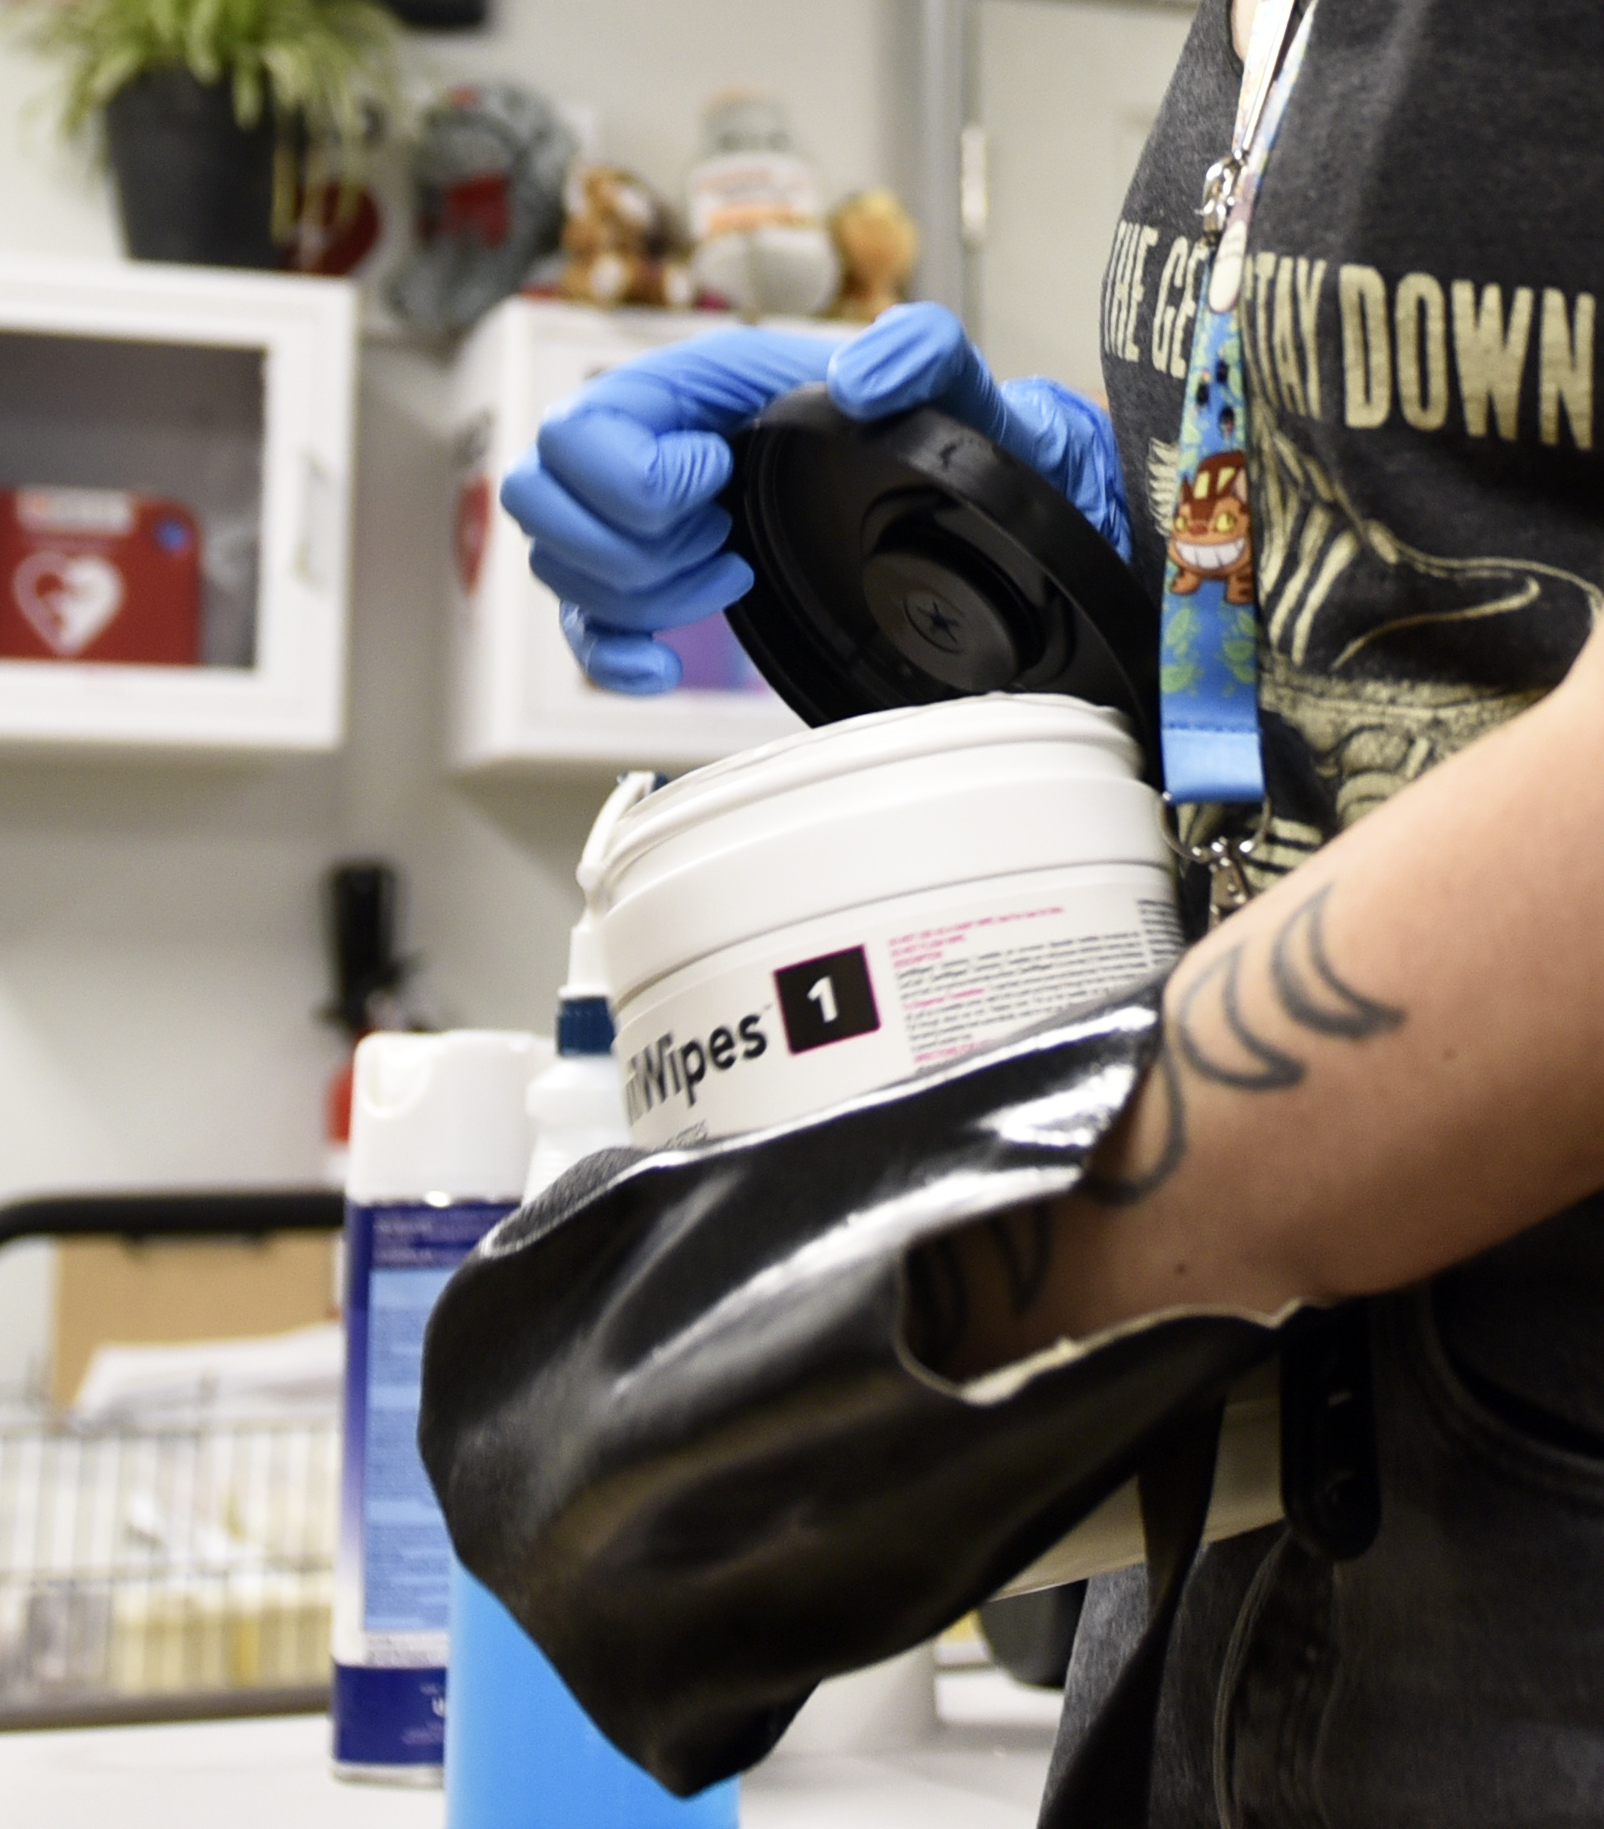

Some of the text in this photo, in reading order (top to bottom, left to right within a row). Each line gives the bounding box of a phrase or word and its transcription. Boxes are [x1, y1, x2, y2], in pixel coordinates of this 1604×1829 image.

[1101, 219, 1160, 363] THE
[1338, 262, 1597, 451] DOWN
[806, 975, 839, 1023] 1
